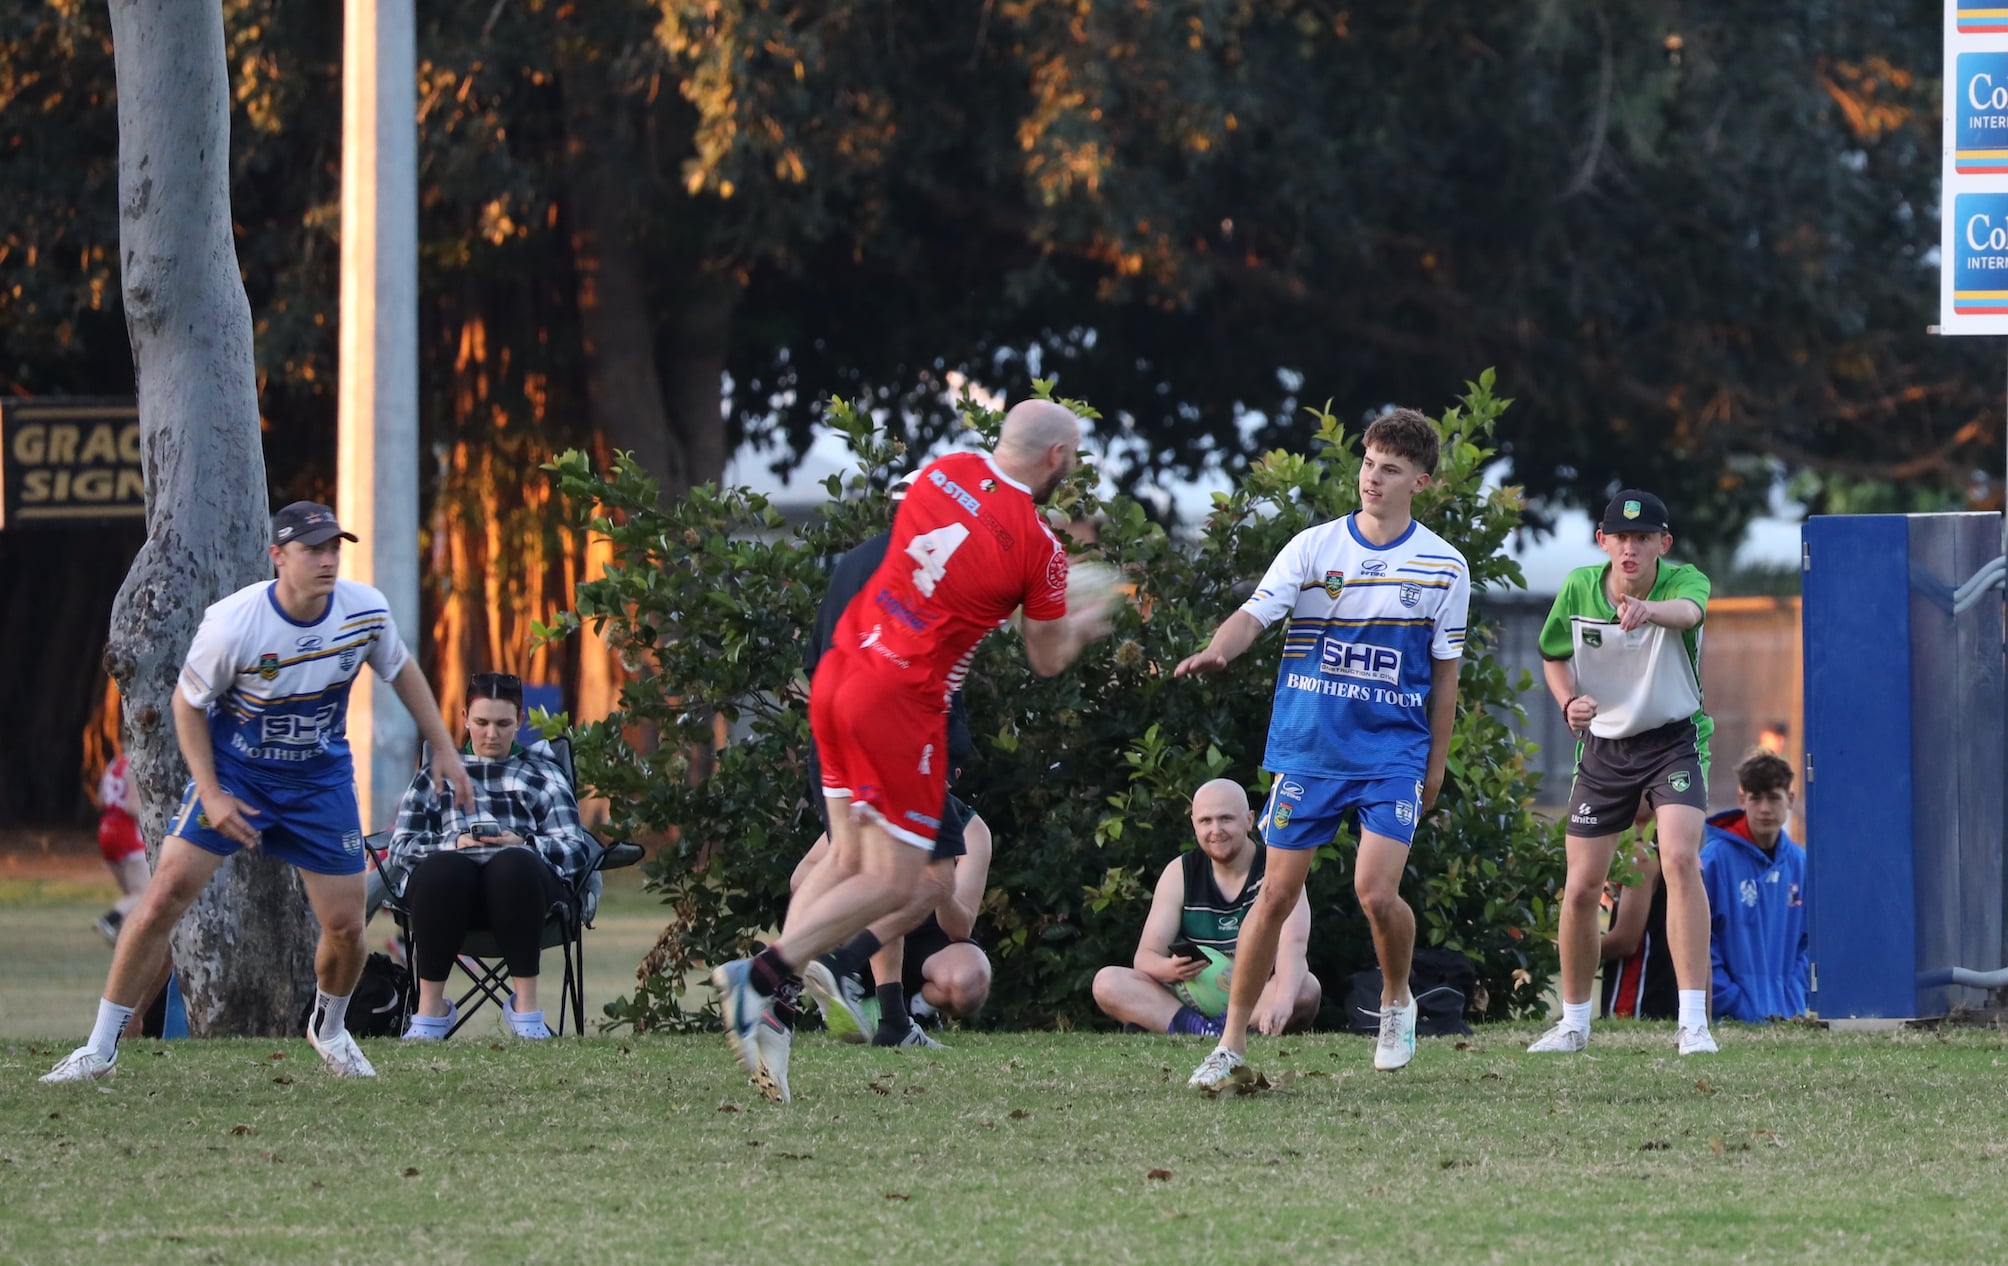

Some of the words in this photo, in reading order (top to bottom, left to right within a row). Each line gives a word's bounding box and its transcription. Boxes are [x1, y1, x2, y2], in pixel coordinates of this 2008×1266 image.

[1969, 116, 2008, 129] INTER
[903, 521, 971, 598] 4
[1322, 640, 1398, 672] SHP
[1286, 673, 1371, 701] BROTHERS
